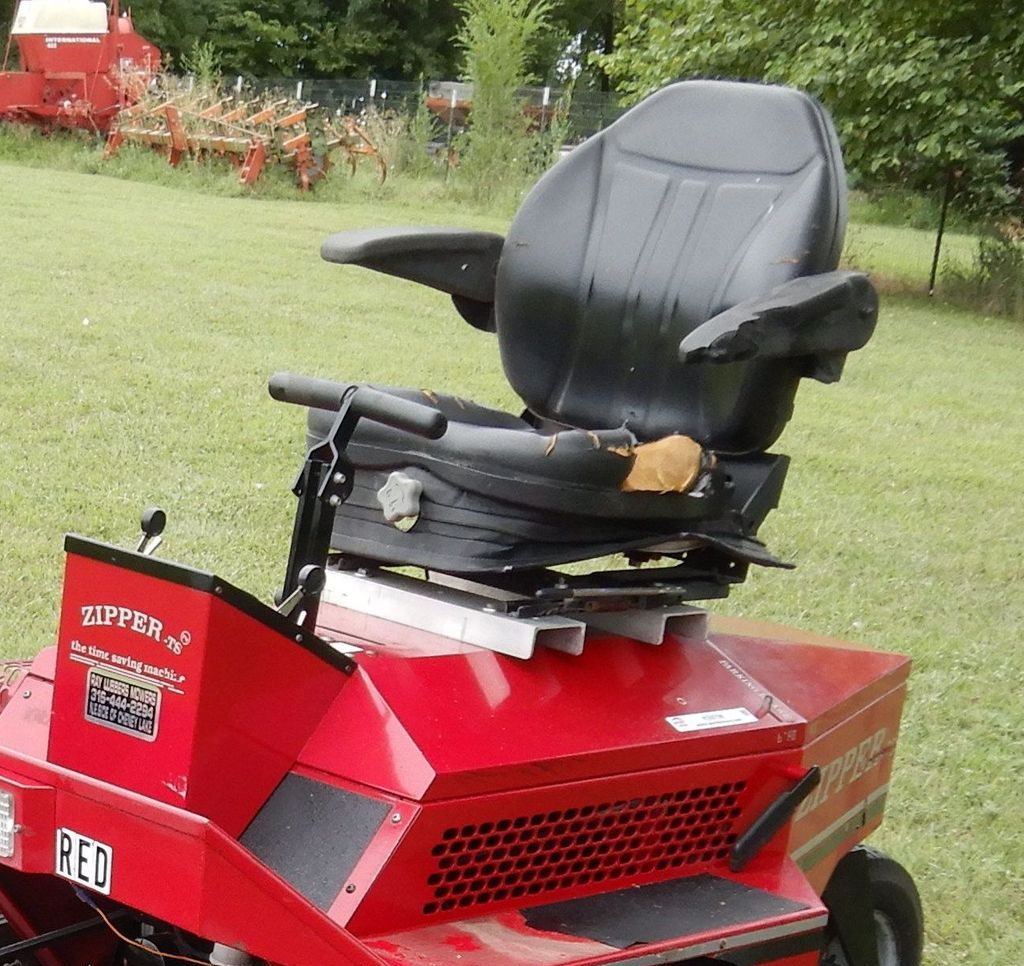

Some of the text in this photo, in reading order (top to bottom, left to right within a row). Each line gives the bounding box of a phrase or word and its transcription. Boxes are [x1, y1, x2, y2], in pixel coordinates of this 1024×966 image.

[81, 605, 163, 642] ZIPPER
[70, 640, 87, 653] the
[88, 645, 110, 661] time
[111, 654, 143, 674] saving
[59, 832, 108, 889] RED
